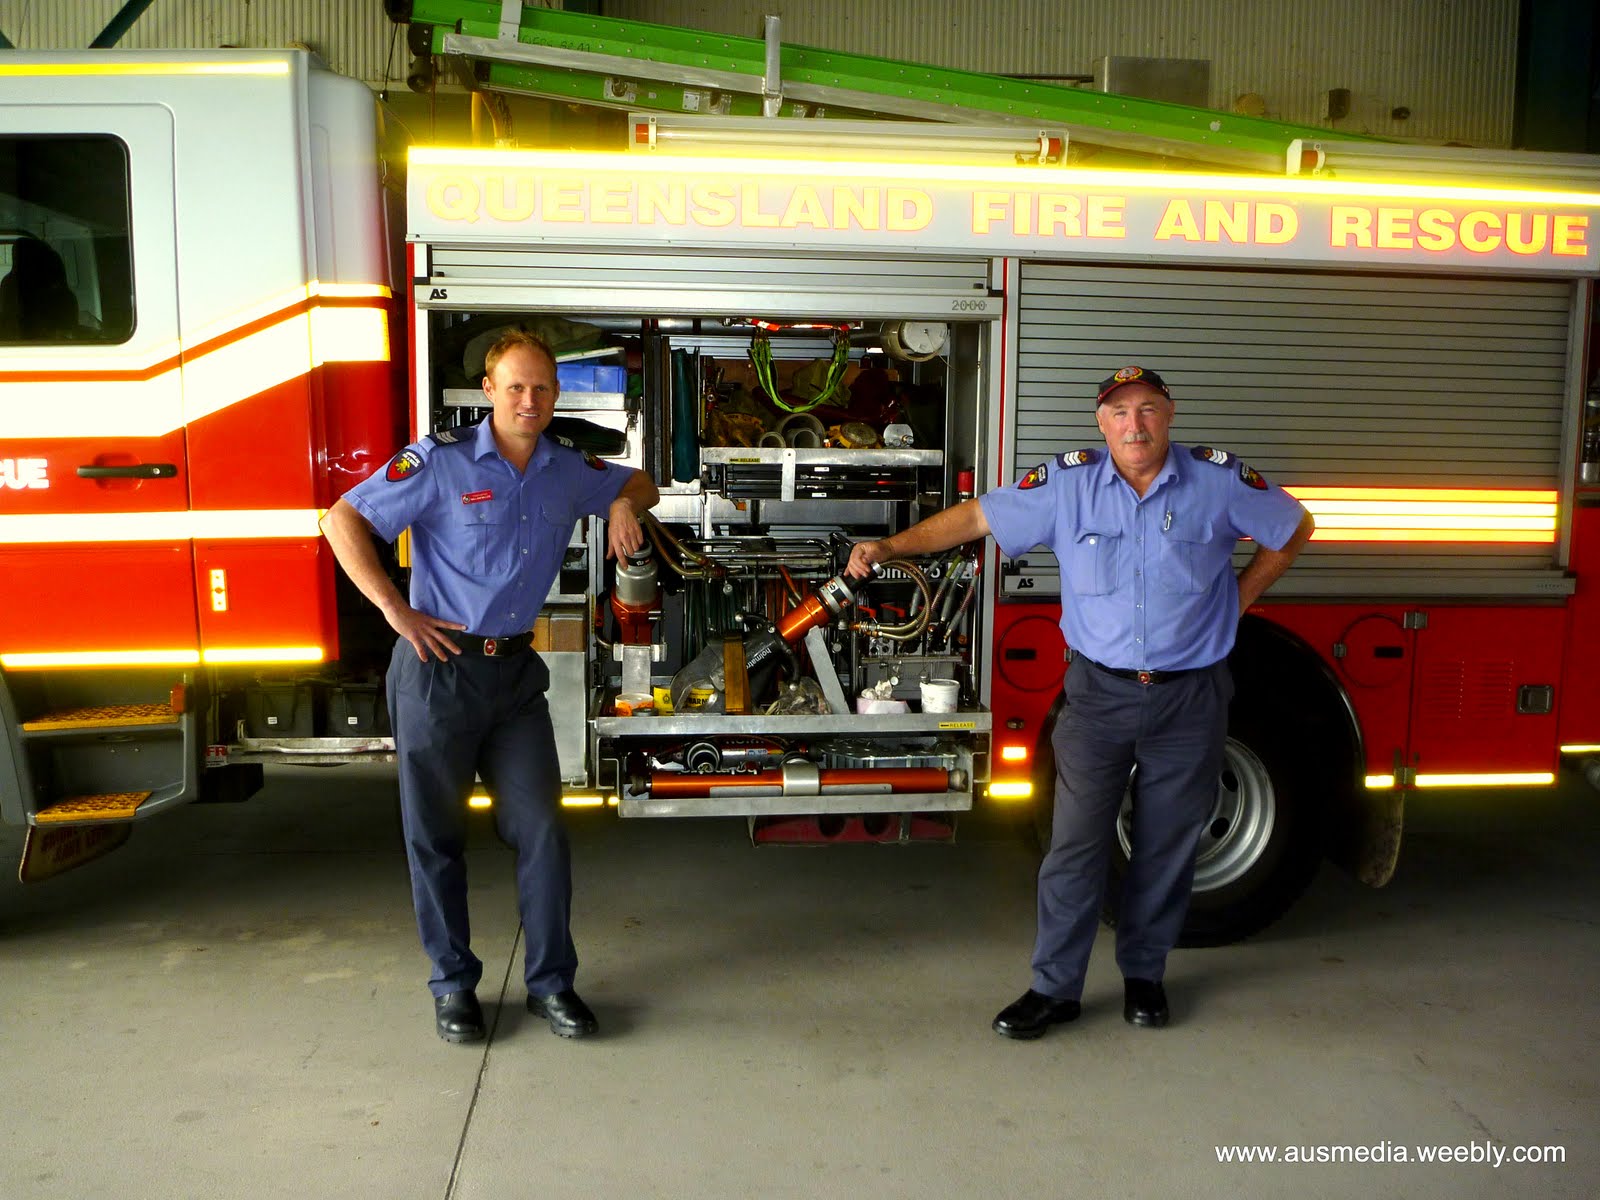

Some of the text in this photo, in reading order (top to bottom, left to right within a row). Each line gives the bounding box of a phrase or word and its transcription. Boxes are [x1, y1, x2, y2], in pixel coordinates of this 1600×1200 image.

[426, 174, 1589, 256] QUEENSLAND FIRE AND RESCUE
[429, 288, 448, 300] AS
[0, 458, 50, 490] UE
[1017, 578, 1034, 590] AS
